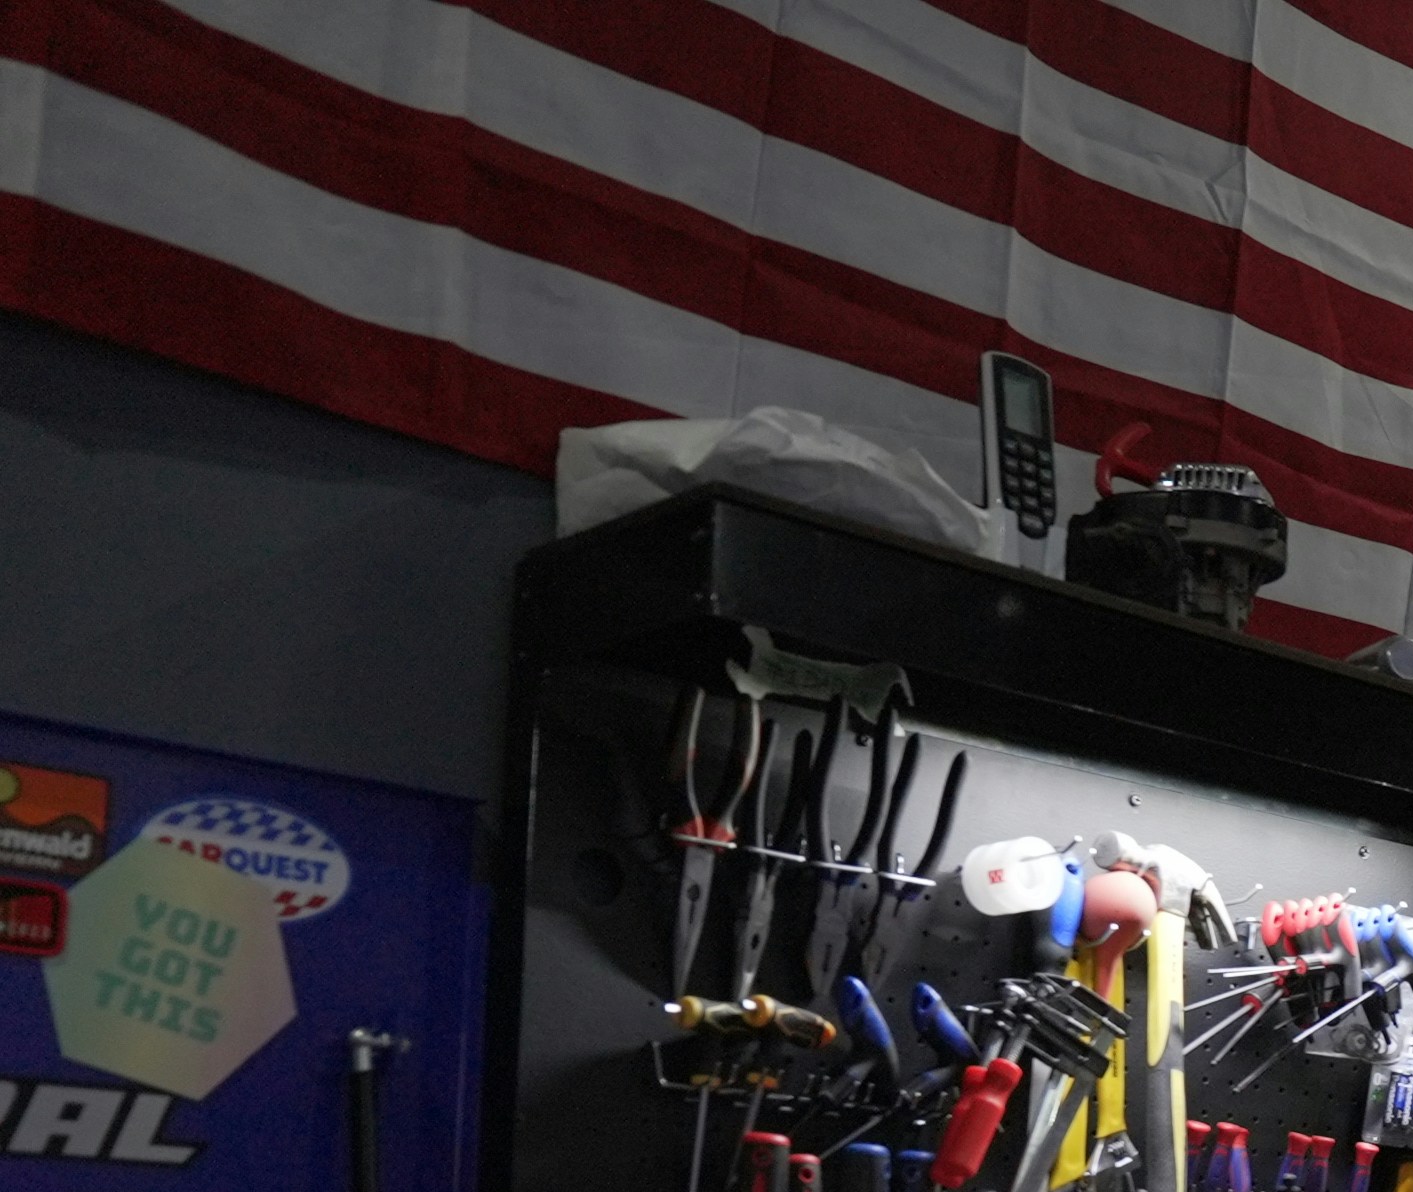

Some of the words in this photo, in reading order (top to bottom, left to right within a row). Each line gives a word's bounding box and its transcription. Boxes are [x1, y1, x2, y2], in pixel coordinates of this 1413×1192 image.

[158, 836, 329, 884] ARQUEST
[133, 893, 237, 960] YOU
[118, 934, 223, 997] GOT
[94, 969, 222, 1043] THIS
